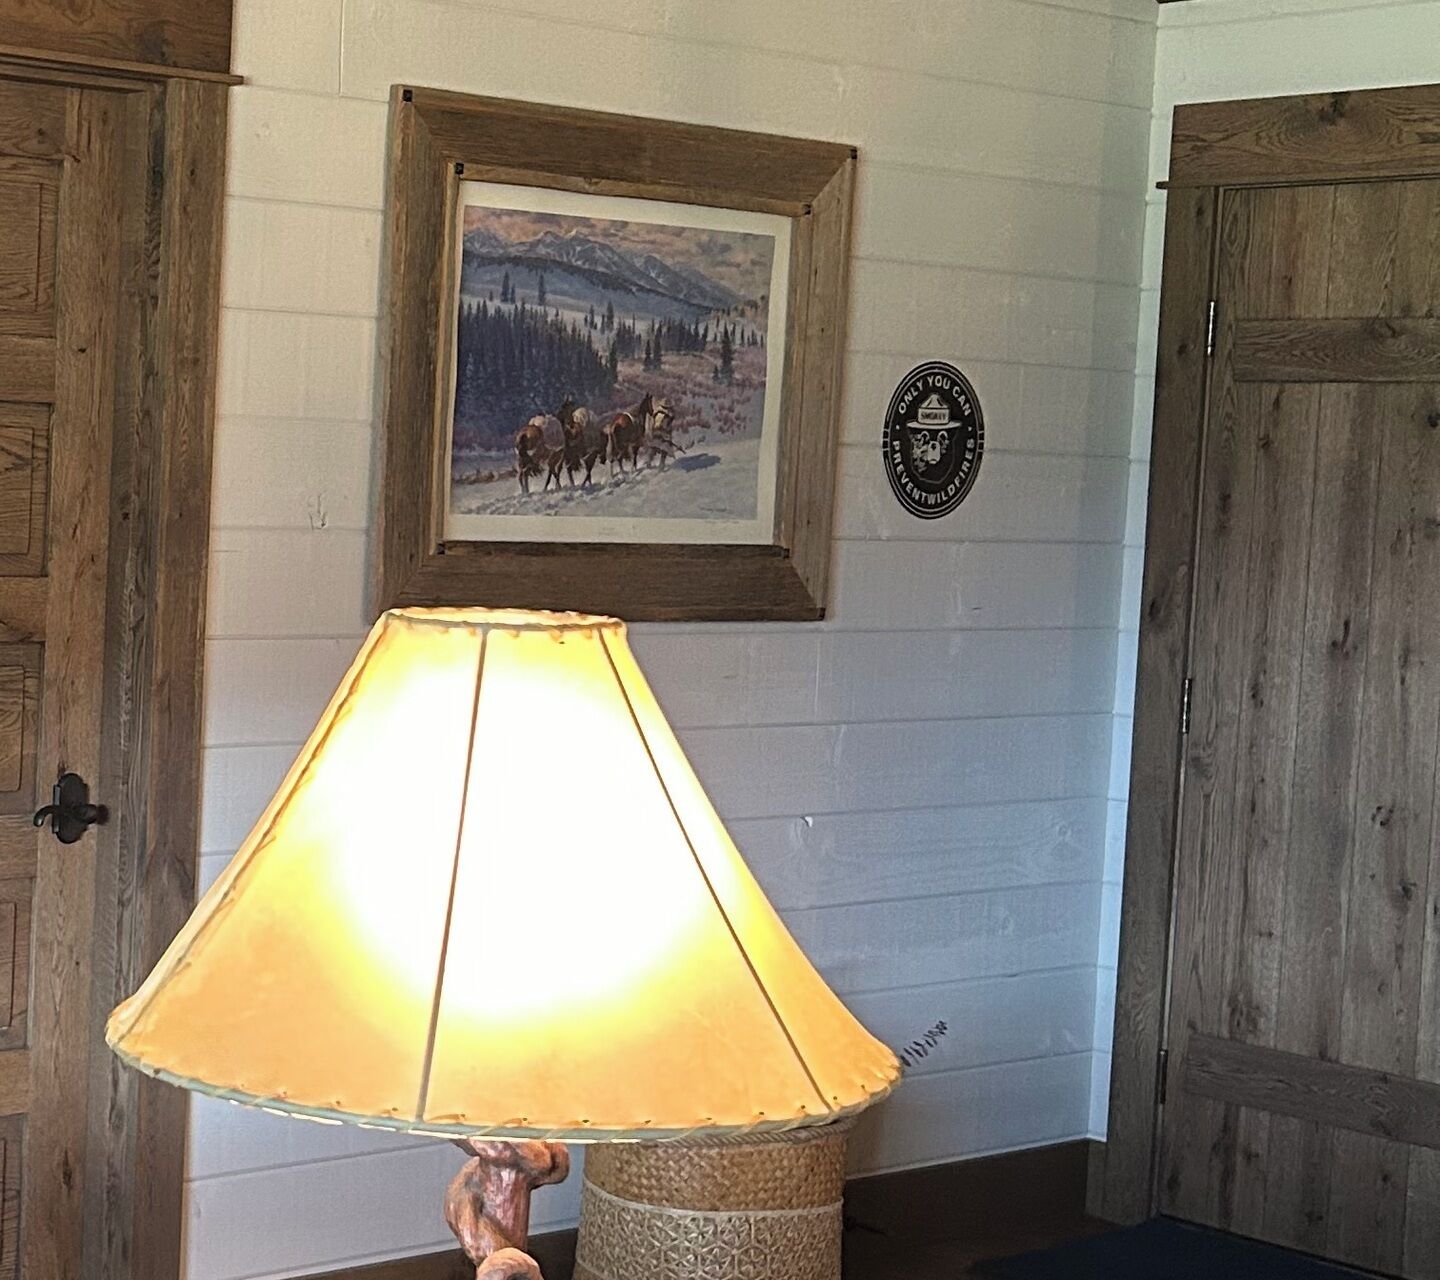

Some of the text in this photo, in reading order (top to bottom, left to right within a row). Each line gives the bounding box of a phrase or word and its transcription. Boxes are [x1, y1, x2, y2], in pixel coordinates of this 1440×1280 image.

[898, 375, 972, 417] ONLY YOU CAN
